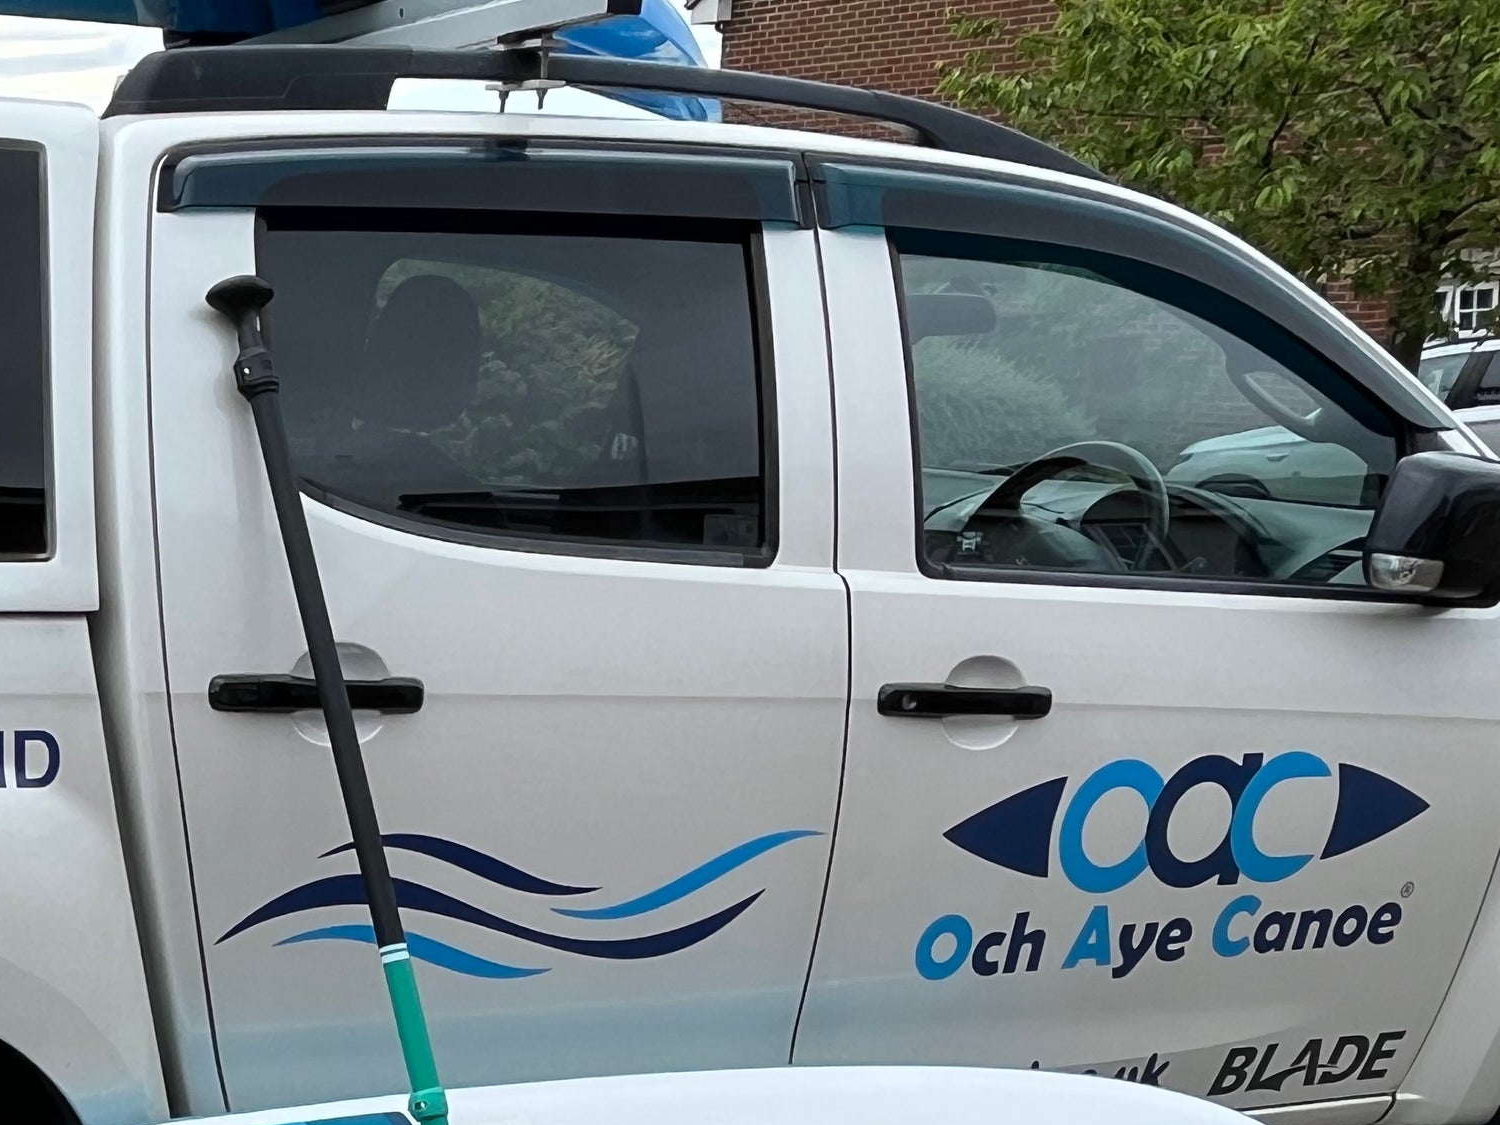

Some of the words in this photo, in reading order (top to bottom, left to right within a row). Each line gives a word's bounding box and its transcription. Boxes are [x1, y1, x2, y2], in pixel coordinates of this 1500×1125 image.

[914, 909, 1047, 981] Och
[1061, 905, 1193, 979] Aye
[1206, 1029, 1408, 1097] BLADE
